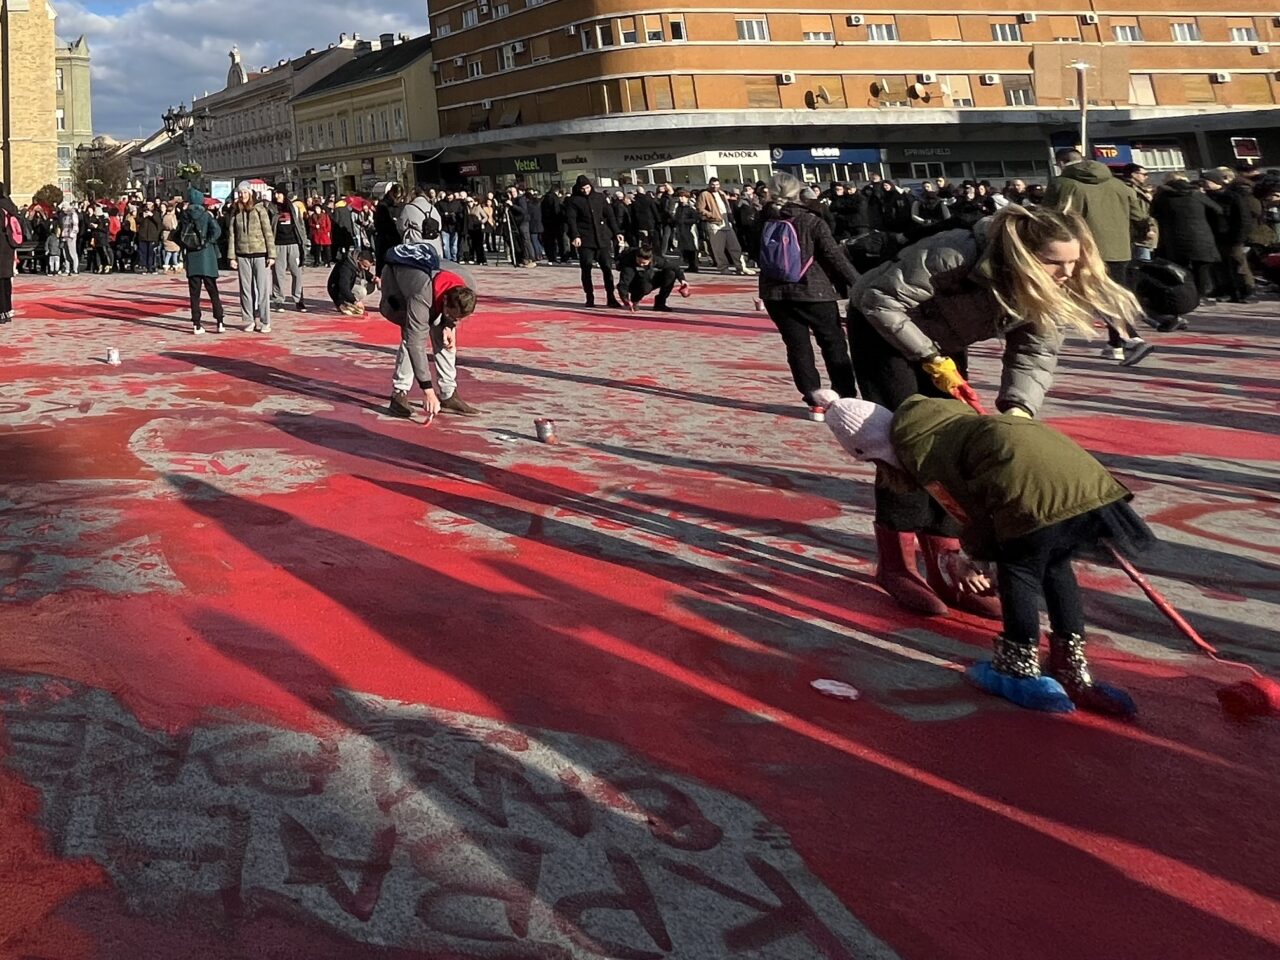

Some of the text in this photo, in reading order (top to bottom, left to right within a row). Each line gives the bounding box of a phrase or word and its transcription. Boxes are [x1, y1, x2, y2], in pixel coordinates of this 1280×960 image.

[624, 152, 673, 162] PANDORA
[719, 150, 758, 158] PANDORA
[904, 148, 951, 157] SPRINGFIELD
